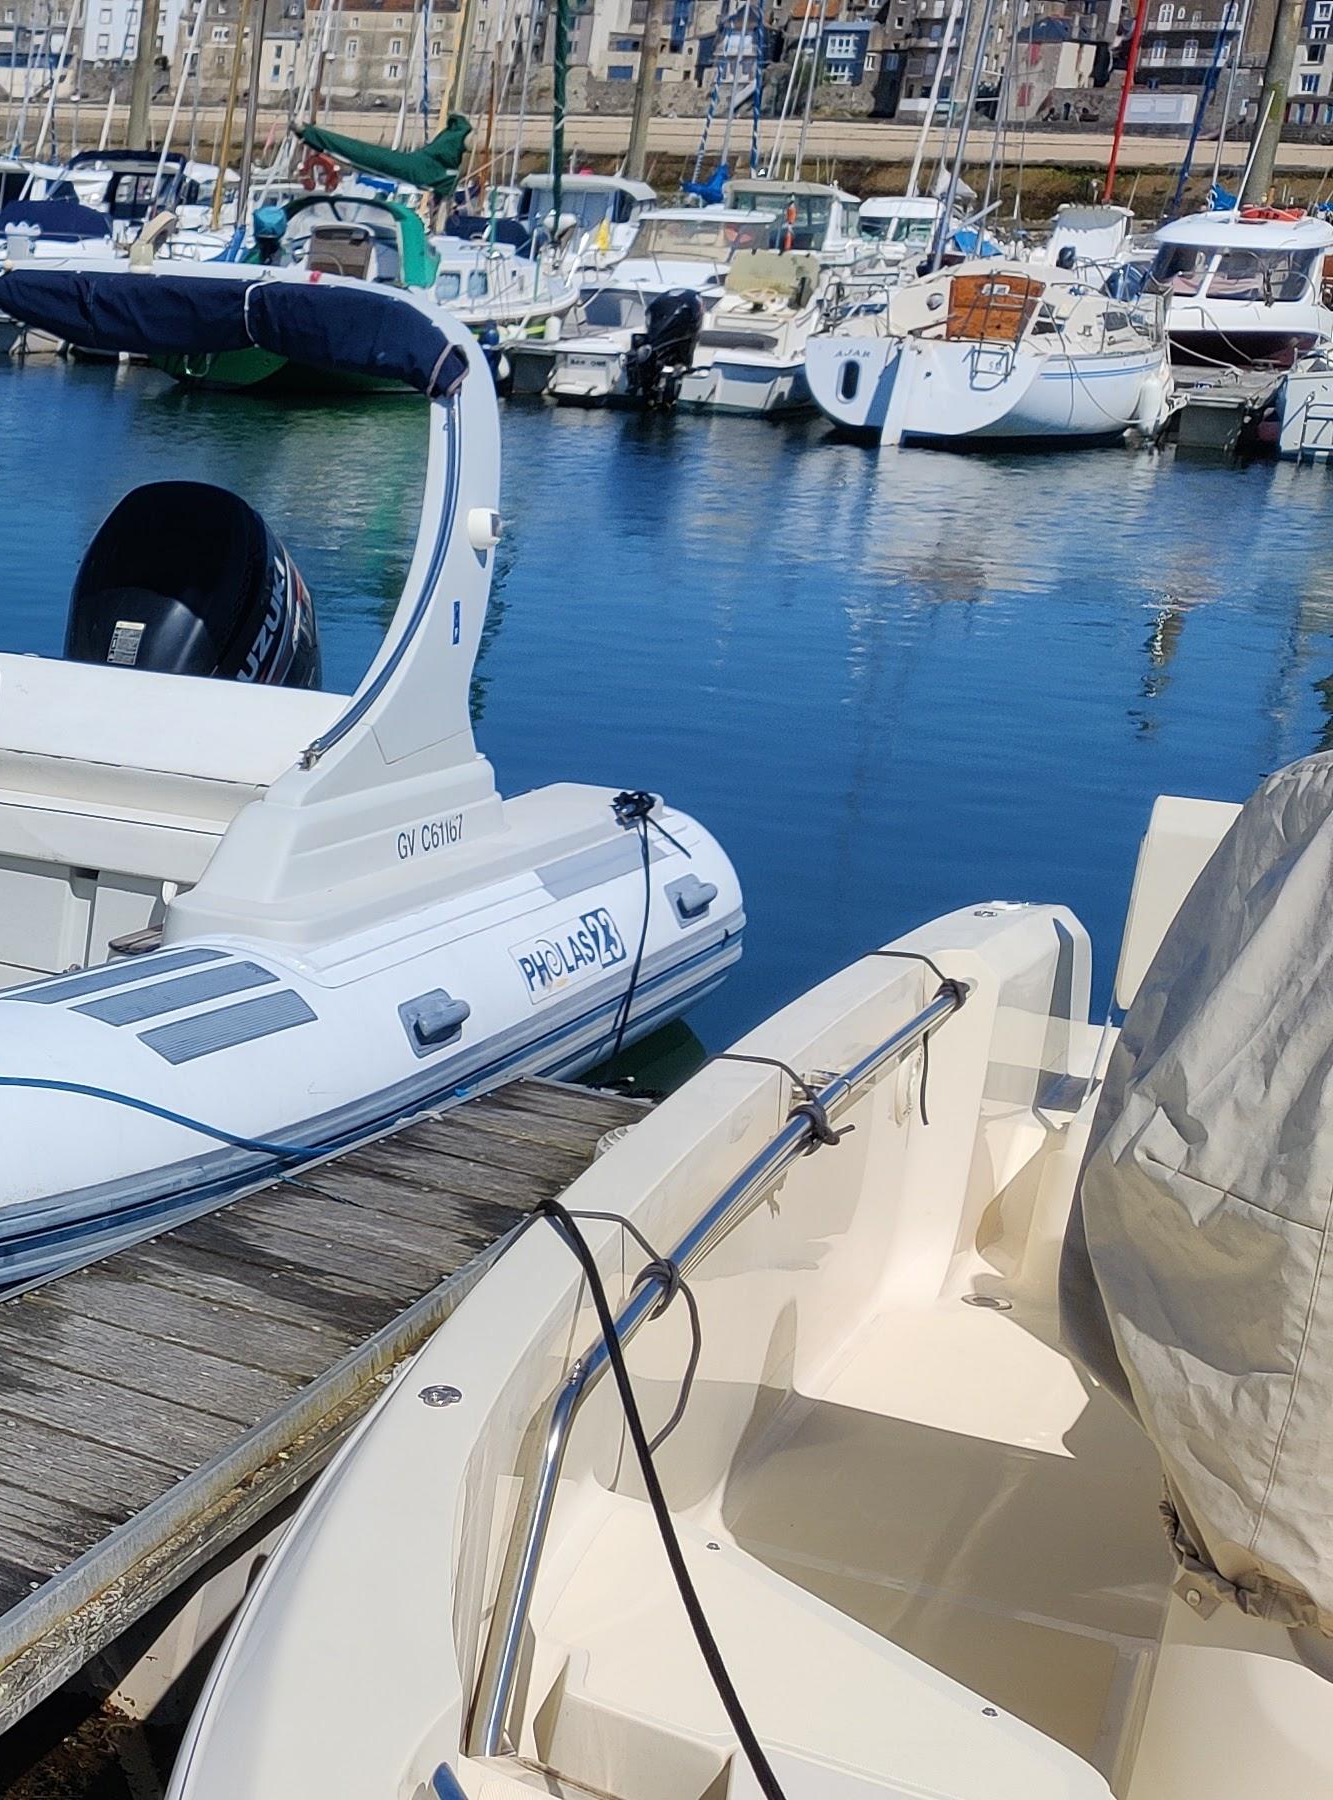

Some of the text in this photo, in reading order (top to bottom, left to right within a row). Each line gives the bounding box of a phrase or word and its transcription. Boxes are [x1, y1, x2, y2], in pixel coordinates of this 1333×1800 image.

[236, 555, 286, 682] UZUKI
[397, 813, 463, 860] GV C61167
[518, 909, 624, 991] PHOLAS 23
